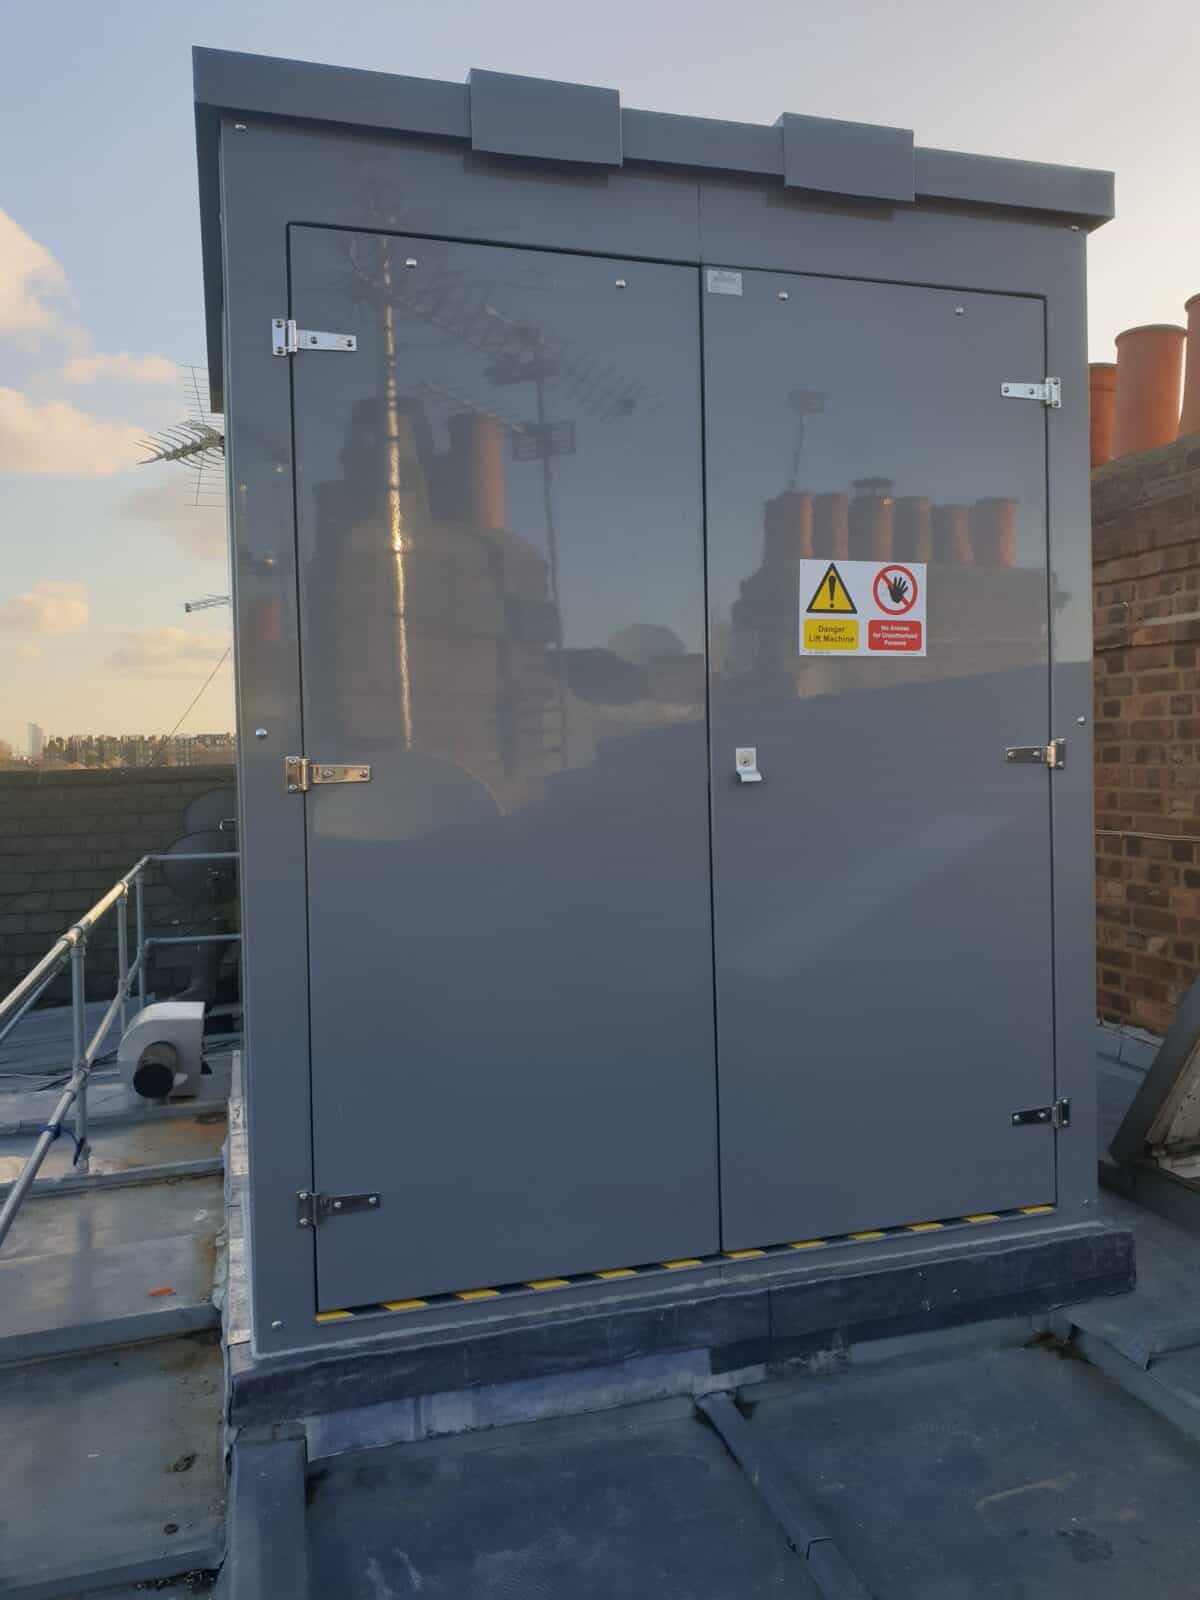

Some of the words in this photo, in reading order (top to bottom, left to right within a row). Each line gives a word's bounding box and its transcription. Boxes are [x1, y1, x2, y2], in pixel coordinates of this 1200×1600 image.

[818, 625, 845, 635] Danger
[809, 635, 821, 643] Lift
[823, 635, 854, 643] Machine
